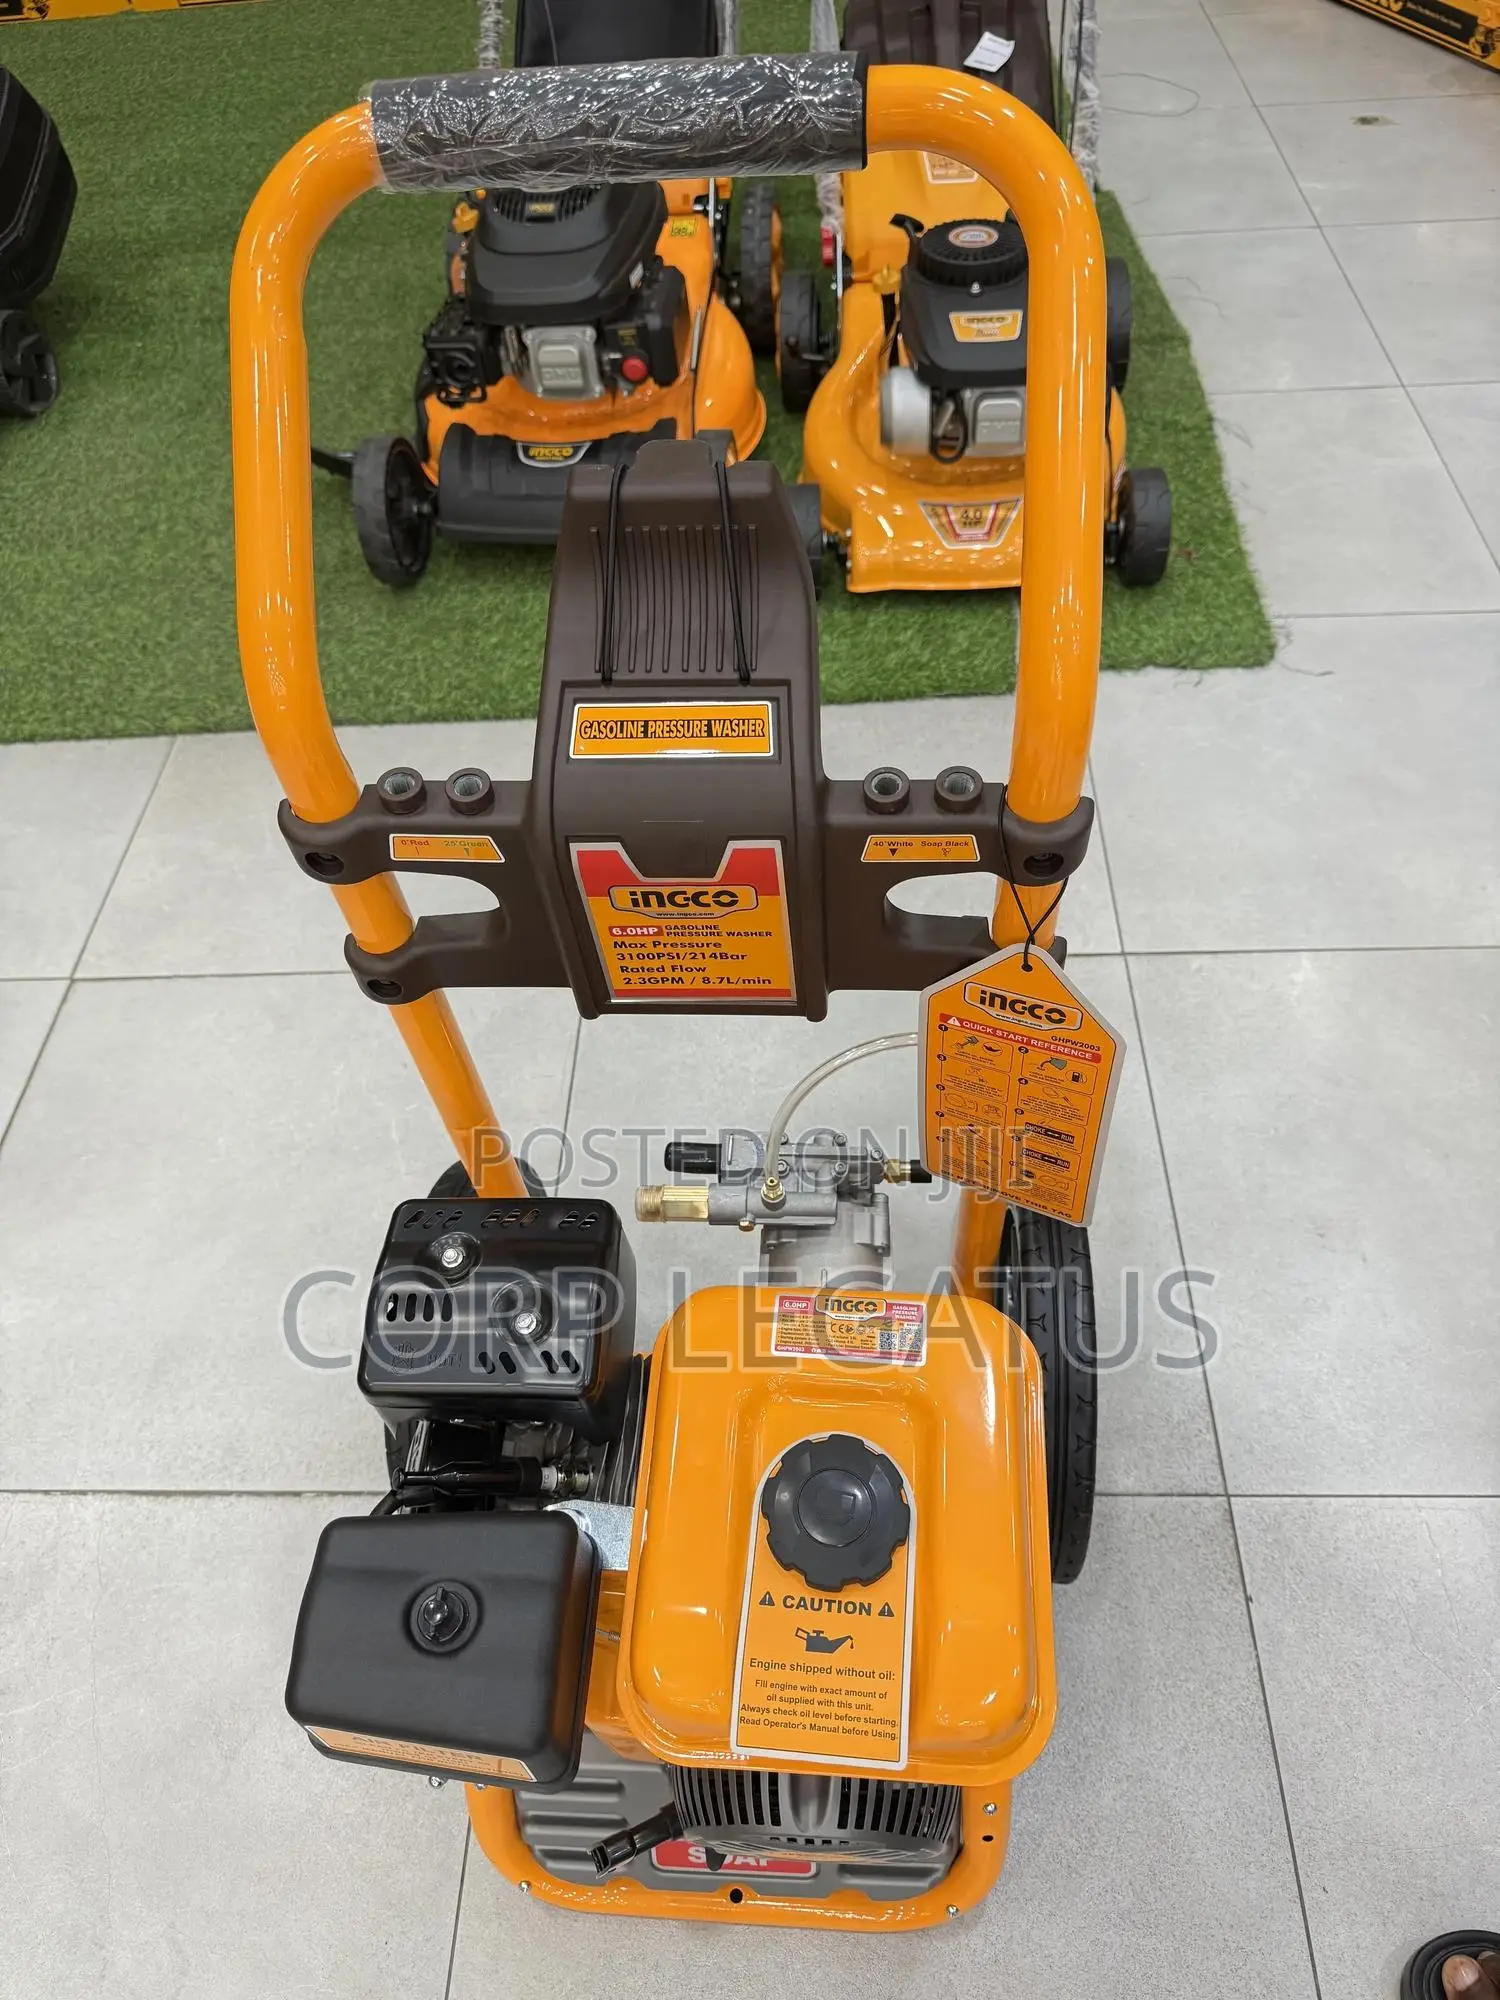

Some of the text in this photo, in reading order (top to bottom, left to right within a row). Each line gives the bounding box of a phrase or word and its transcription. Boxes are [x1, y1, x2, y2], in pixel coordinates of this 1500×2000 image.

[580, 719, 766, 739] GASOLINE PRESSURE WASHER
[945, 840, 970, 848] Black
[612, 927, 658, 936] 6.0HP
[613, 940, 722, 949] Max Pressure
[616, 952, 748, 961] 3100PSI/214Bar
[620, 965, 707, 973] Rated Flow
[624, 977, 685, 985] 2.3GPM
[701, 977, 772, 985] 8.7L/min
[962, 1021, 1093, 1060] QUICK START REFERENCE
[1051, 1035, 1101, 1051] GHPW2003
[1025, 1124, 1074, 1142] CHOKE RUN
[1056, 1160, 1070, 1168] RUN
[1025, 1199, 1047, 1210] THIS
[1052, 1208, 1072, 1218] TAG
[782, 1595, 872, 1616] CAUTION
[749, 1657, 895, 1681] Engine shipped without oil:
[755, 1679, 887, 1700] Fill engine with exact amount of
[766, 1693, 874, 1712] oil supplied with this unit.
[740, 1703, 771, 1715] Always
[772, 1707, 798, 1717] check
[800, 1709, 811, 1718] oil
[812, 1711, 833, 1720] level
[834, 1713, 862, 1723] before
[739, 1716, 761, 1726] Read
[763, 1718, 807, 1730] Operator's
[809, 1723, 840, 1734] Manual
[841, 1726, 869, 1737] before
